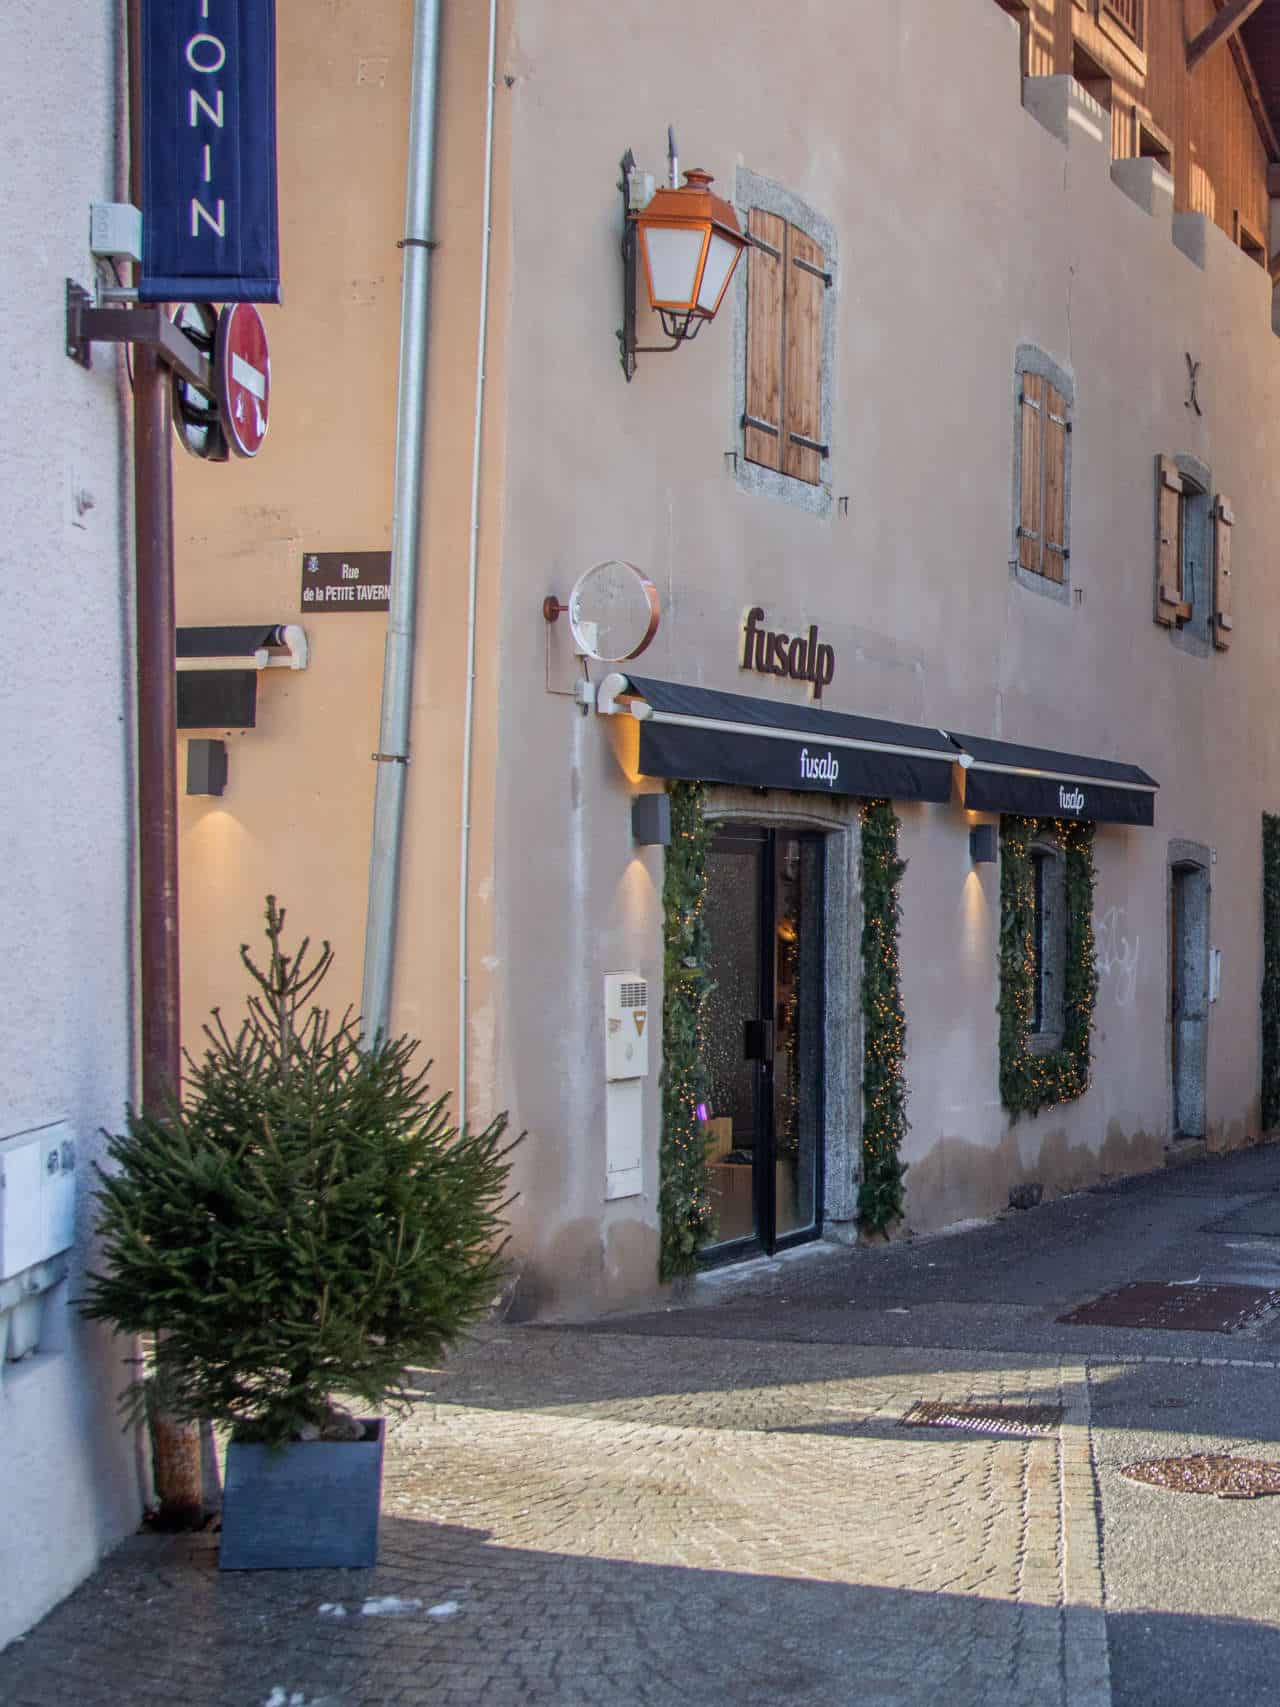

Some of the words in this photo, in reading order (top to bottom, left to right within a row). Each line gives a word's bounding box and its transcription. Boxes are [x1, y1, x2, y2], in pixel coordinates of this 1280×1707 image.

[342, 563, 360, 579] Rue
[303, 587, 314, 601] de
[316, 587, 324, 601] la
[325, 585, 355, 601] PETITE
[743, 607, 835, 699] fusalp
[801, 748, 839, 787] fusalp
[1059, 784, 1085, 815] fusalp
